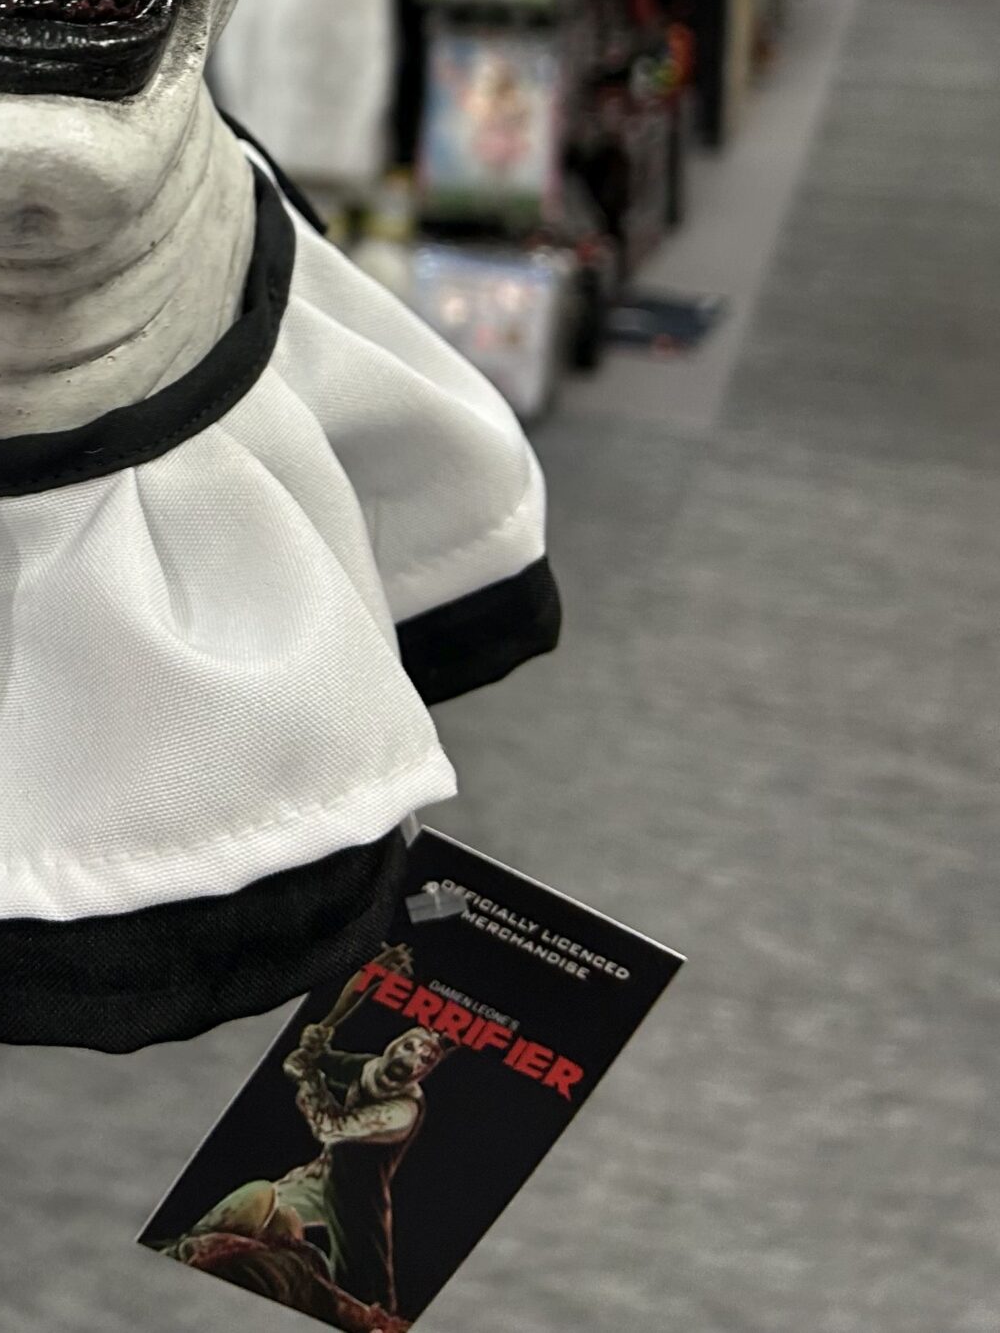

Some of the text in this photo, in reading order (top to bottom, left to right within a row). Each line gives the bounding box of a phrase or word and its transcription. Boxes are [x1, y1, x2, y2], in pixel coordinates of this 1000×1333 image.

[461, 910, 590, 981] MERCHANDISE
[540, 929, 630, 980] LICENCED
[354, 961, 585, 1102] TERRIFIER
